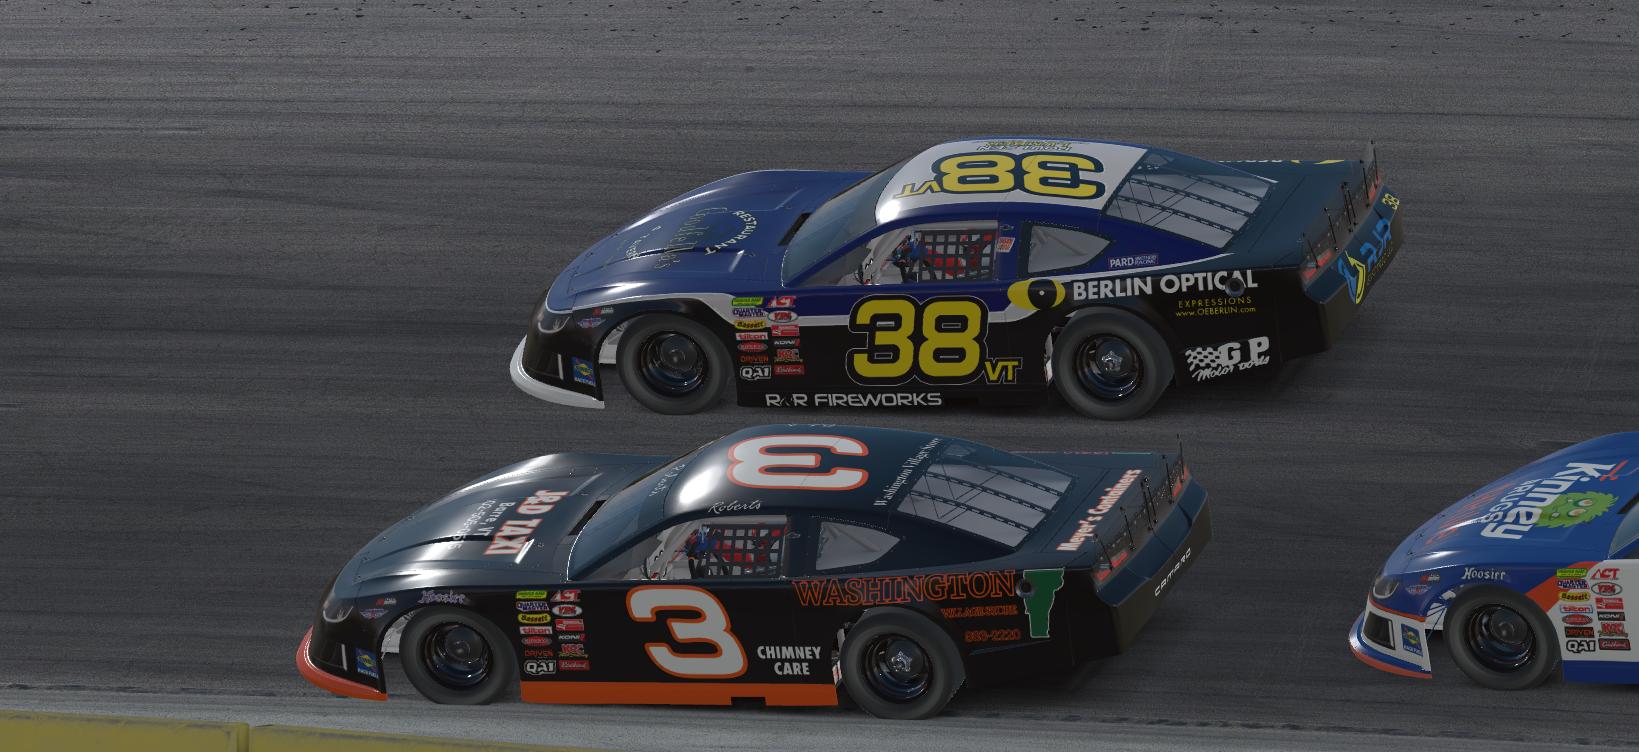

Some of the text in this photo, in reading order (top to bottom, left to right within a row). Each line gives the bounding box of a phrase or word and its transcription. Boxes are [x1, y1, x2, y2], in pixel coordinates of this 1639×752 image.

[932, 151, 1105, 199] 38
[705, 210, 757, 256] RESTAURANT
[1110, 257, 1134, 268] PARD
[1073, 270, 1259, 301] BERLIN OPTICAL
[1178, 297, 1252, 308] EXPRESSIONS
[1175, 307, 1257, 318] www.OEBERLIN.com
[848, 295, 1022, 385] 38 VT
[740, 365, 772, 380] QA1
[814, 392, 942, 407] FIREWORKS
[515, 489, 570, 515] J&D
[708, 499, 762, 514] Roberts
[1481, 462, 1617, 540] Kinney
[484, 518, 544, 555] TAXI
[1154, 547, 1191, 597] CAMARO
[1591, 568, 1620, 579] ACT
[791, 570, 1017, 607] WASHINGTON
[626, 586, 748, 680] 3
[757, 645, 821, 661] CHIMNEY
[1566, 640, 1596, 653] QA1
[524, 660, 557, 675] QA1
[774, 661, 810, 676] CARE
